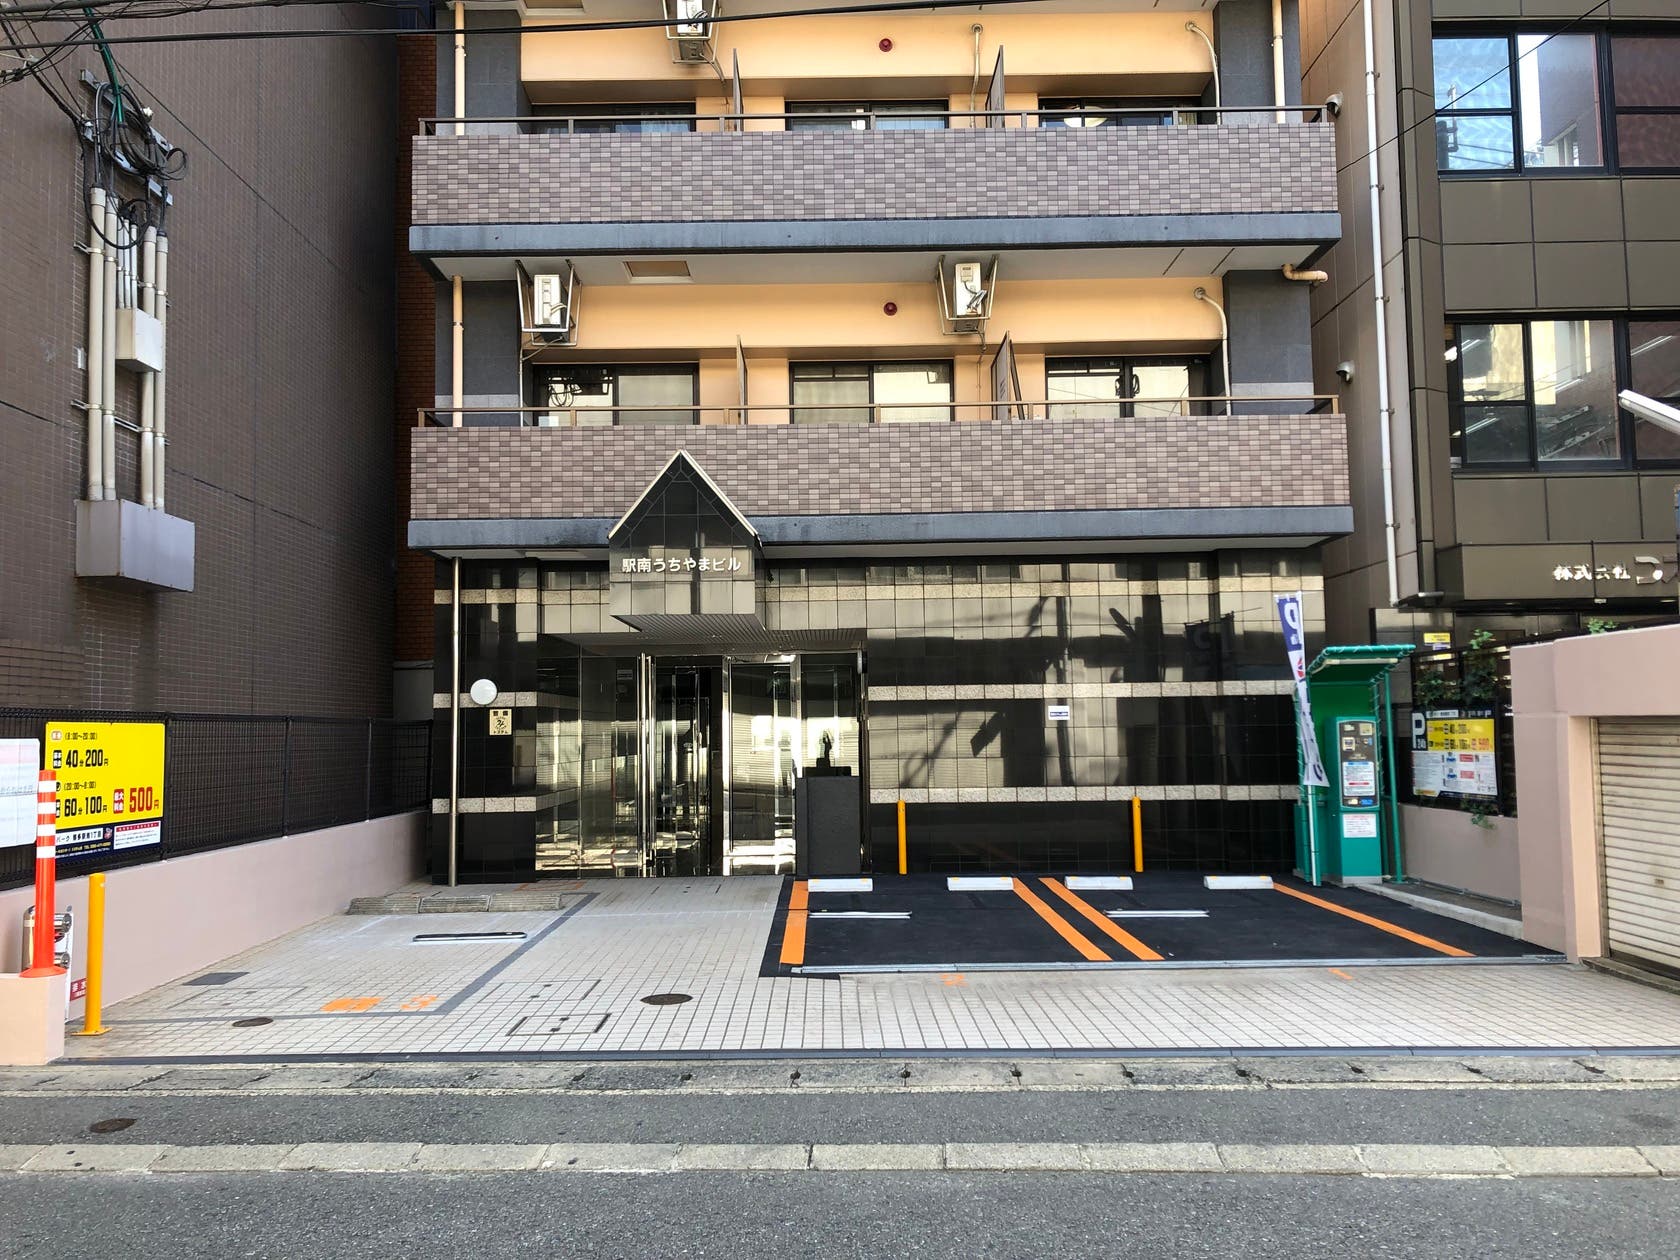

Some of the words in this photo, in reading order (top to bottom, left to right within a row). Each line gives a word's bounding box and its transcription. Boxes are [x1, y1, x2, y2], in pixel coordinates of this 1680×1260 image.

[622, 557, 741, 573] 駅南うちやまビル
